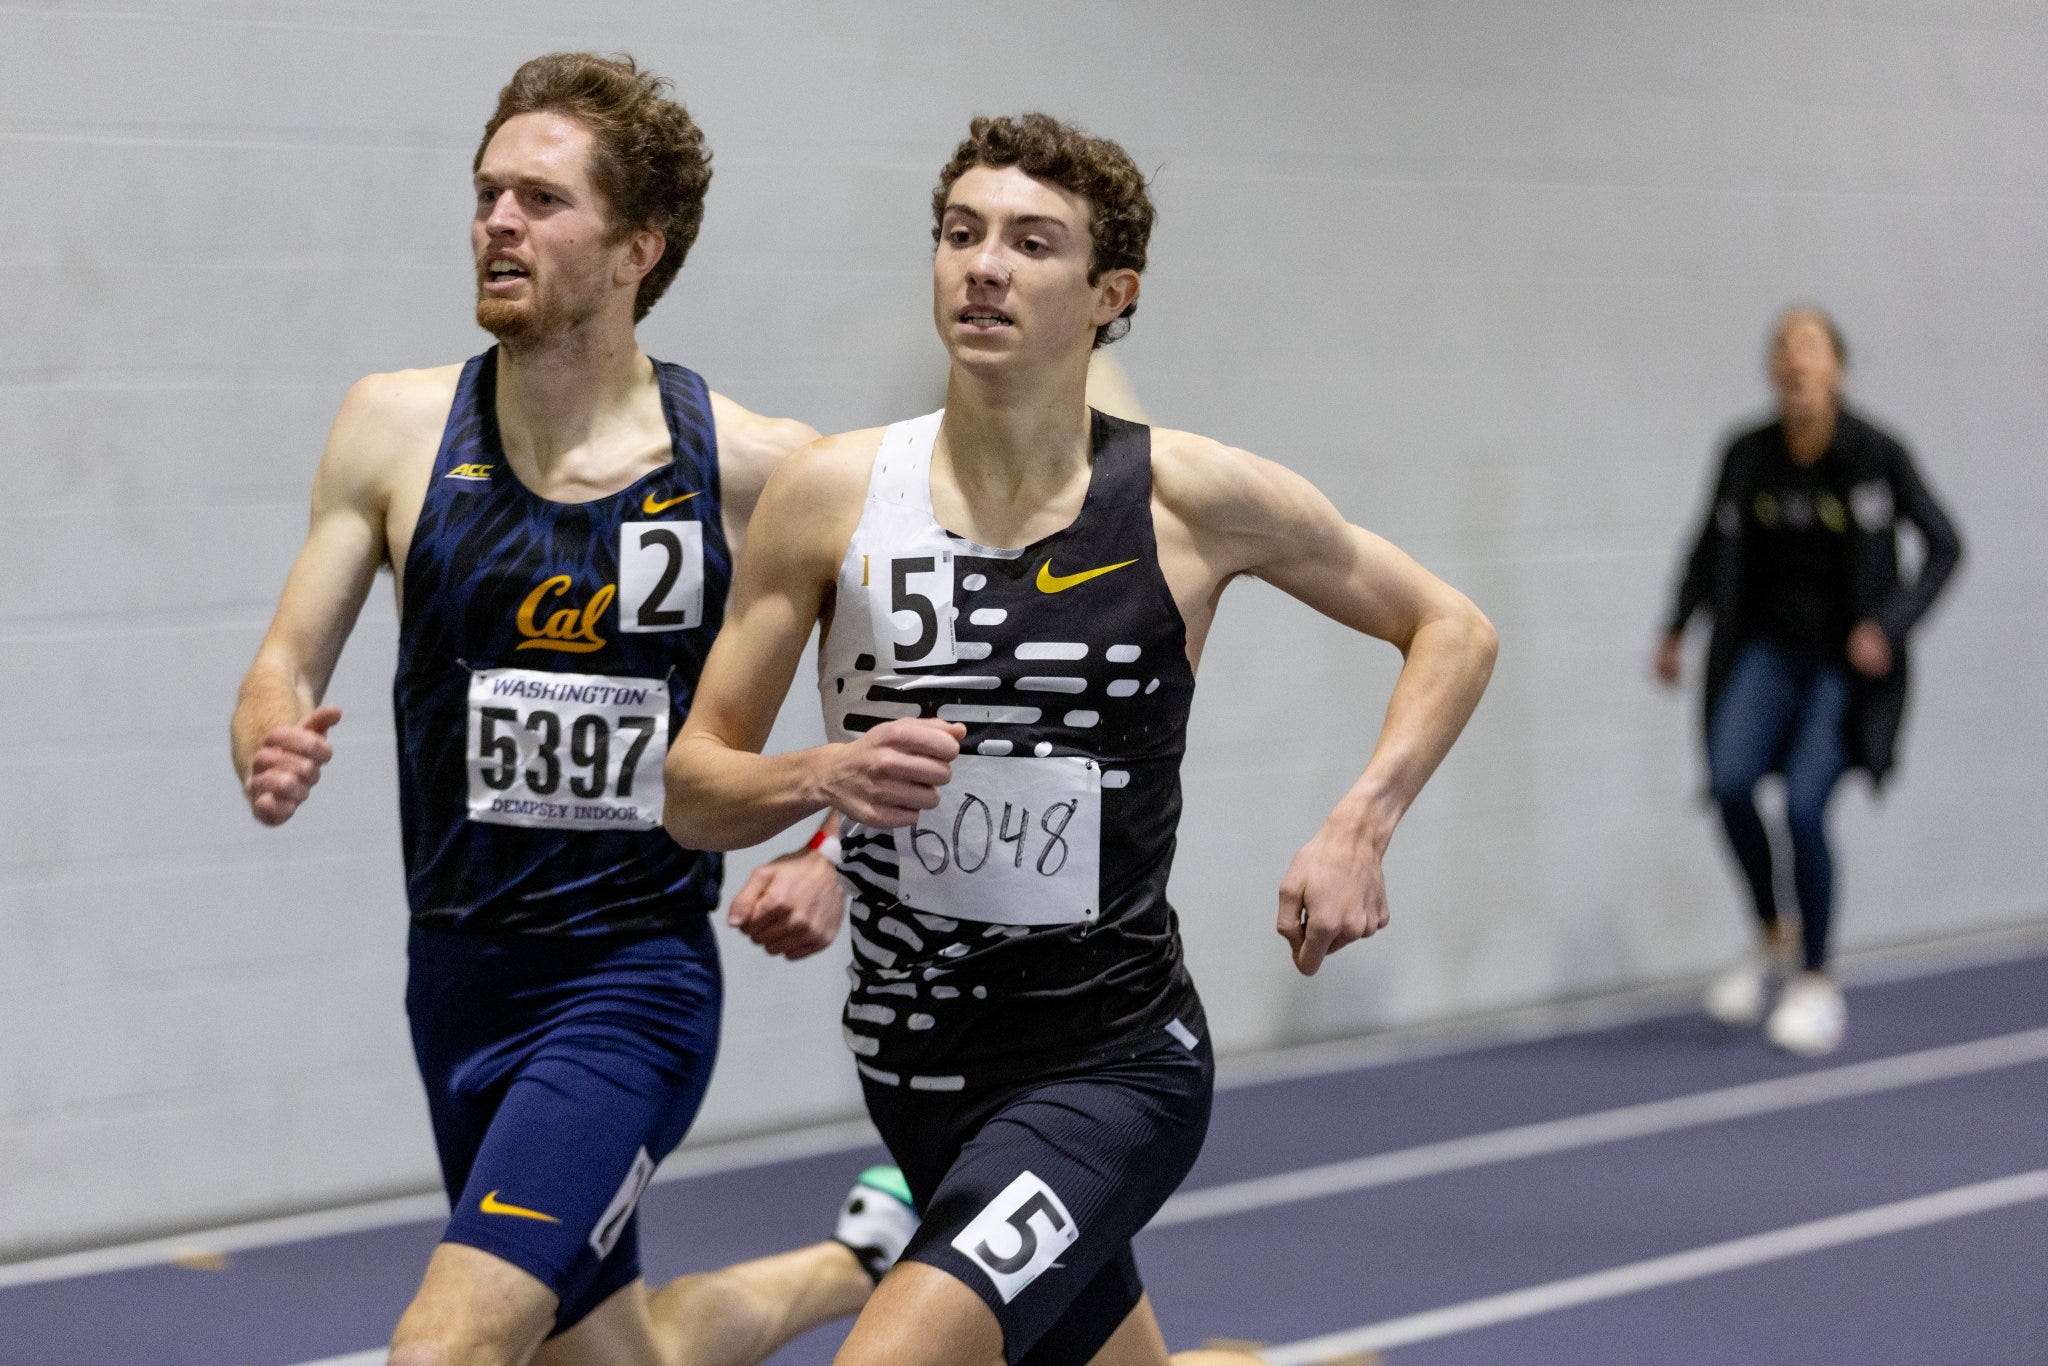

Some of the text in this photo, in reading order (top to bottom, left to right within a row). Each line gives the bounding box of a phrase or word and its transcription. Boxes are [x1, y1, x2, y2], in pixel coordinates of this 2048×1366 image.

[448, 463, 495, 477] ACC
[516, 574, 616, 653] Cal
[637, 528, 686, 626] 2
[891, 556, 938, 662] 5
[493, 679, 648, 705] WASHINGTON
[480, 707, 656, 799] 5397
[491, 799, 638, 821] DEMPSEY INDOOR
[910, 793, 1078, 876] 6048
[973, 1190, 1066, 1275] 5
